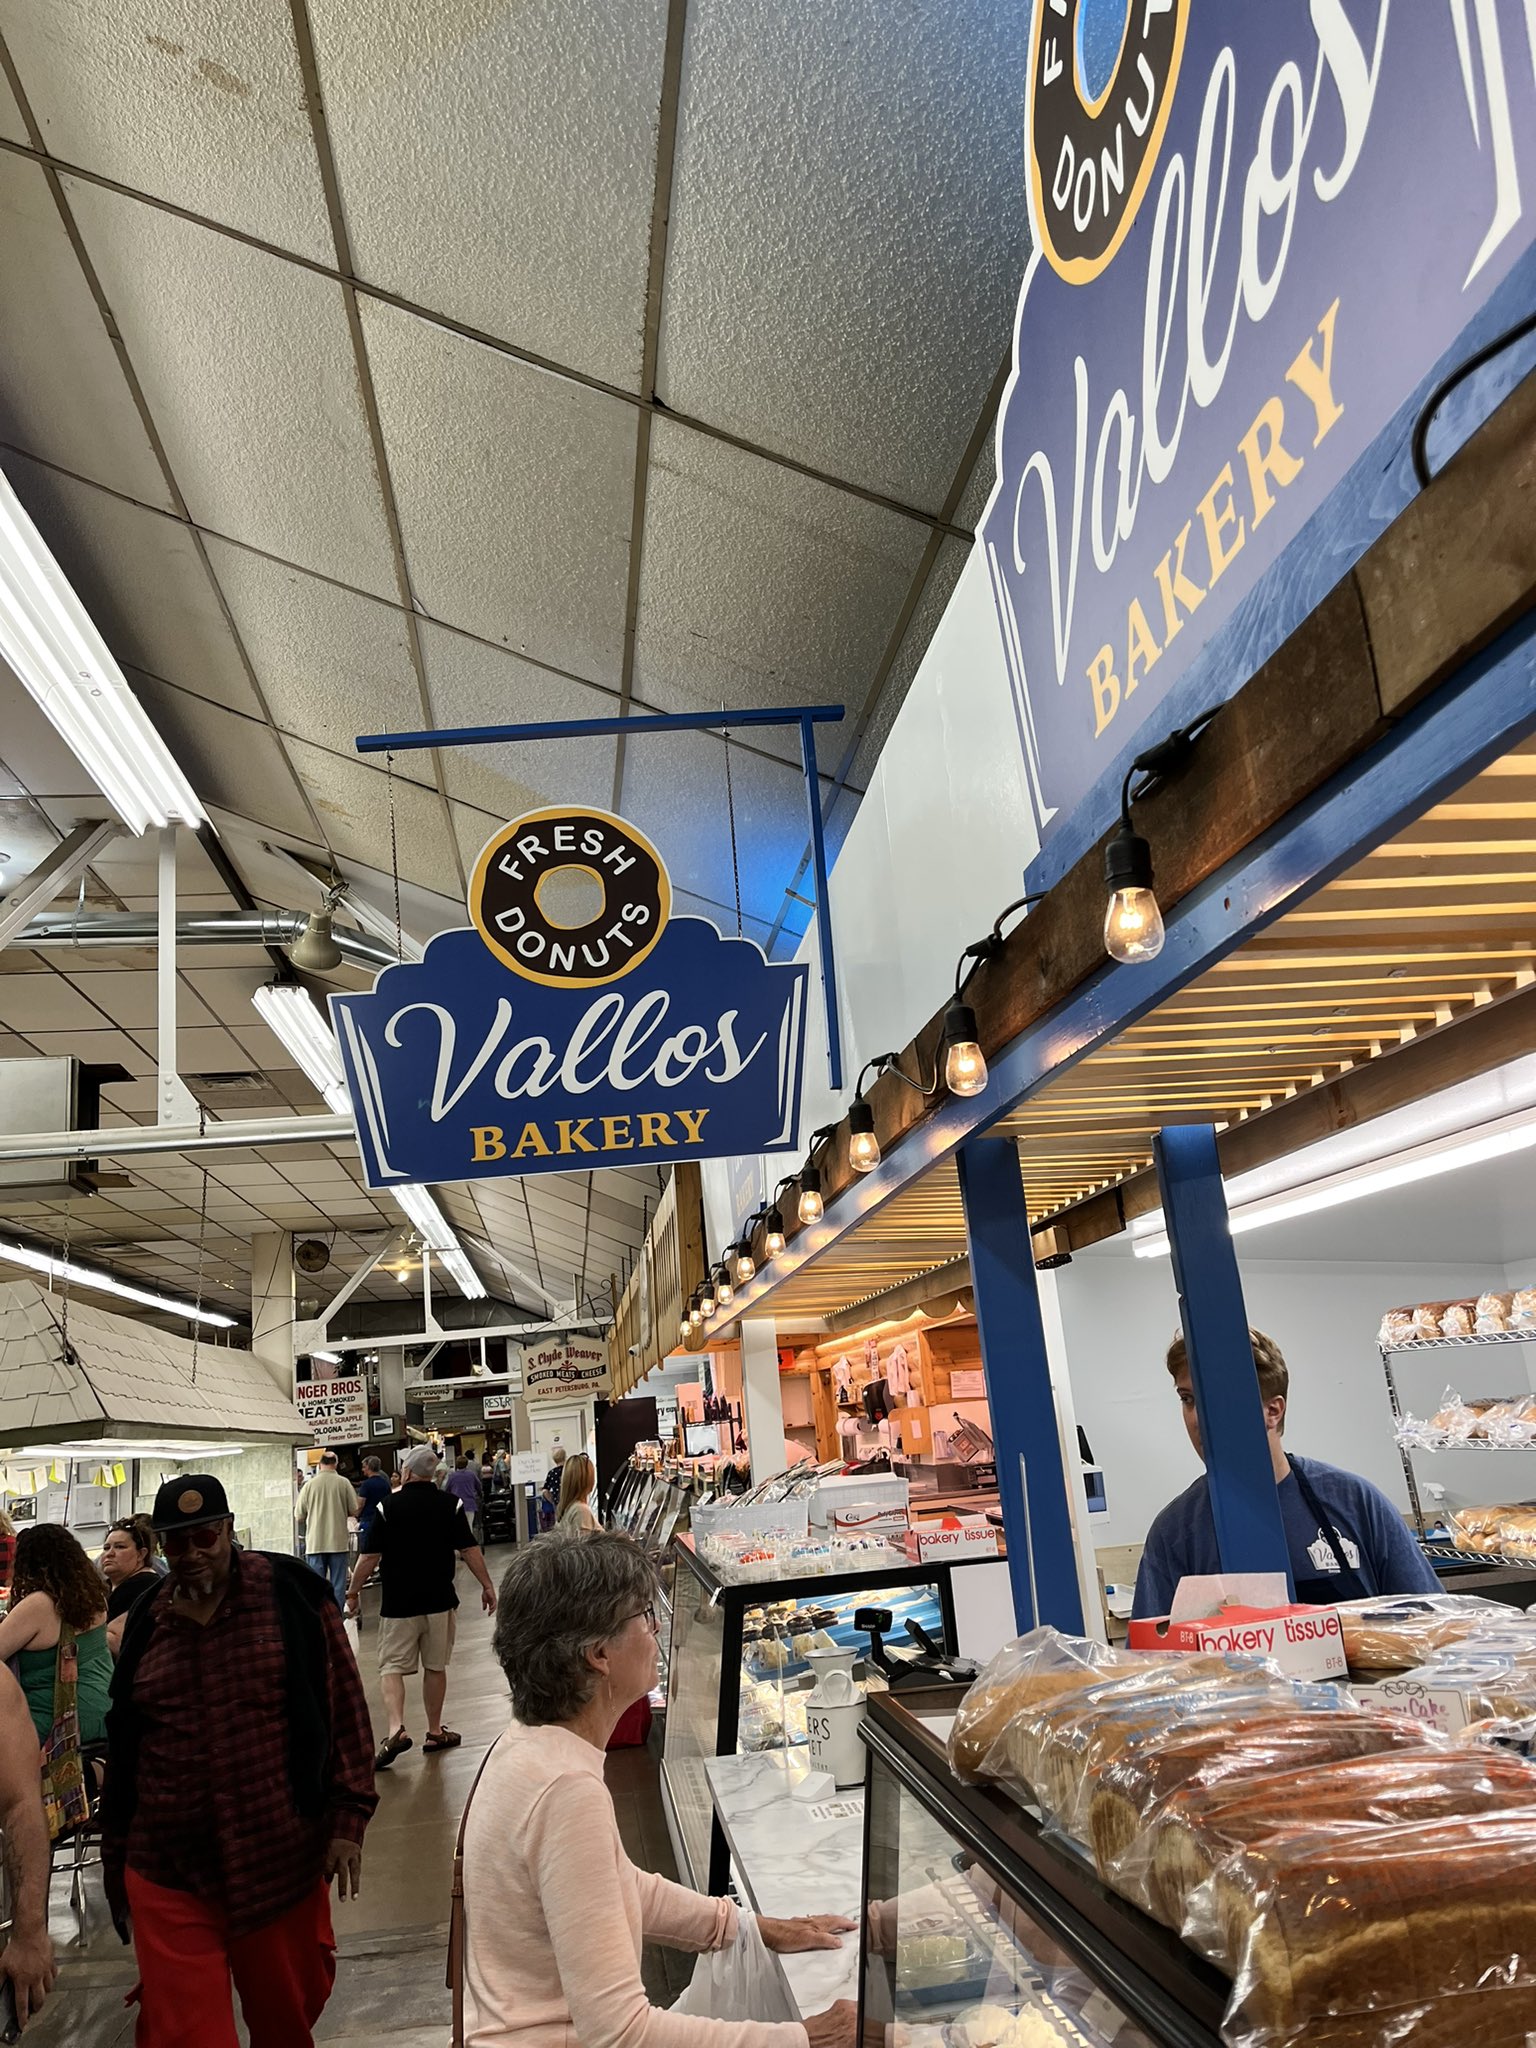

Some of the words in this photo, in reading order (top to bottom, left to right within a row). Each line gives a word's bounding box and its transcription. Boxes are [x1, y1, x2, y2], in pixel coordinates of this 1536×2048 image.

[1013, 0, 1391, 685] Vallos
[1085, 297, 1345, 739] BAKERY
[498, 825, 637, 881] FRESH
[495, 902, 650, 972] DONUTS
[384, 990, 768, 1122] Vallos
[469, 1109, 711, 1162] BAKERY
[538, 1348, 562, 1367] Clyde
[565, 1347, 602, 1362] Weaver
[530, 1370, 554, 1383] SMOKED
[556, 1370, 575, 1379] MEATS
[581, 1367, 603, 1378] CHEESE
[331, 1380, 364, 1396] BROS.
[537, 1387, 553, 1395] EAST
[308, 1399, 327, 1407] HOME
[329, 1396, 356, 1404] SMOKED
[307, 1419, 329, 1427] AUSAGE
[334, 1415, 363, 1424] SCRAPPLE
[314, 1426, 343, 1435] OLOGNA
[919, 1532, 960, 1545] bakery
[964, 1529, 995, 1541] tissue
[1313, 1548, 1354, 1562] Vaos
[1180, 1631, 1194, 1644] BT-8
[1200, 1627, 1275, 1652] bakery
[1284, 1617, 1339, 1643] tissue
[1326, 1656, 1343, 1669] BT-8
[1409, 1698, 1450, 1718] Cake
